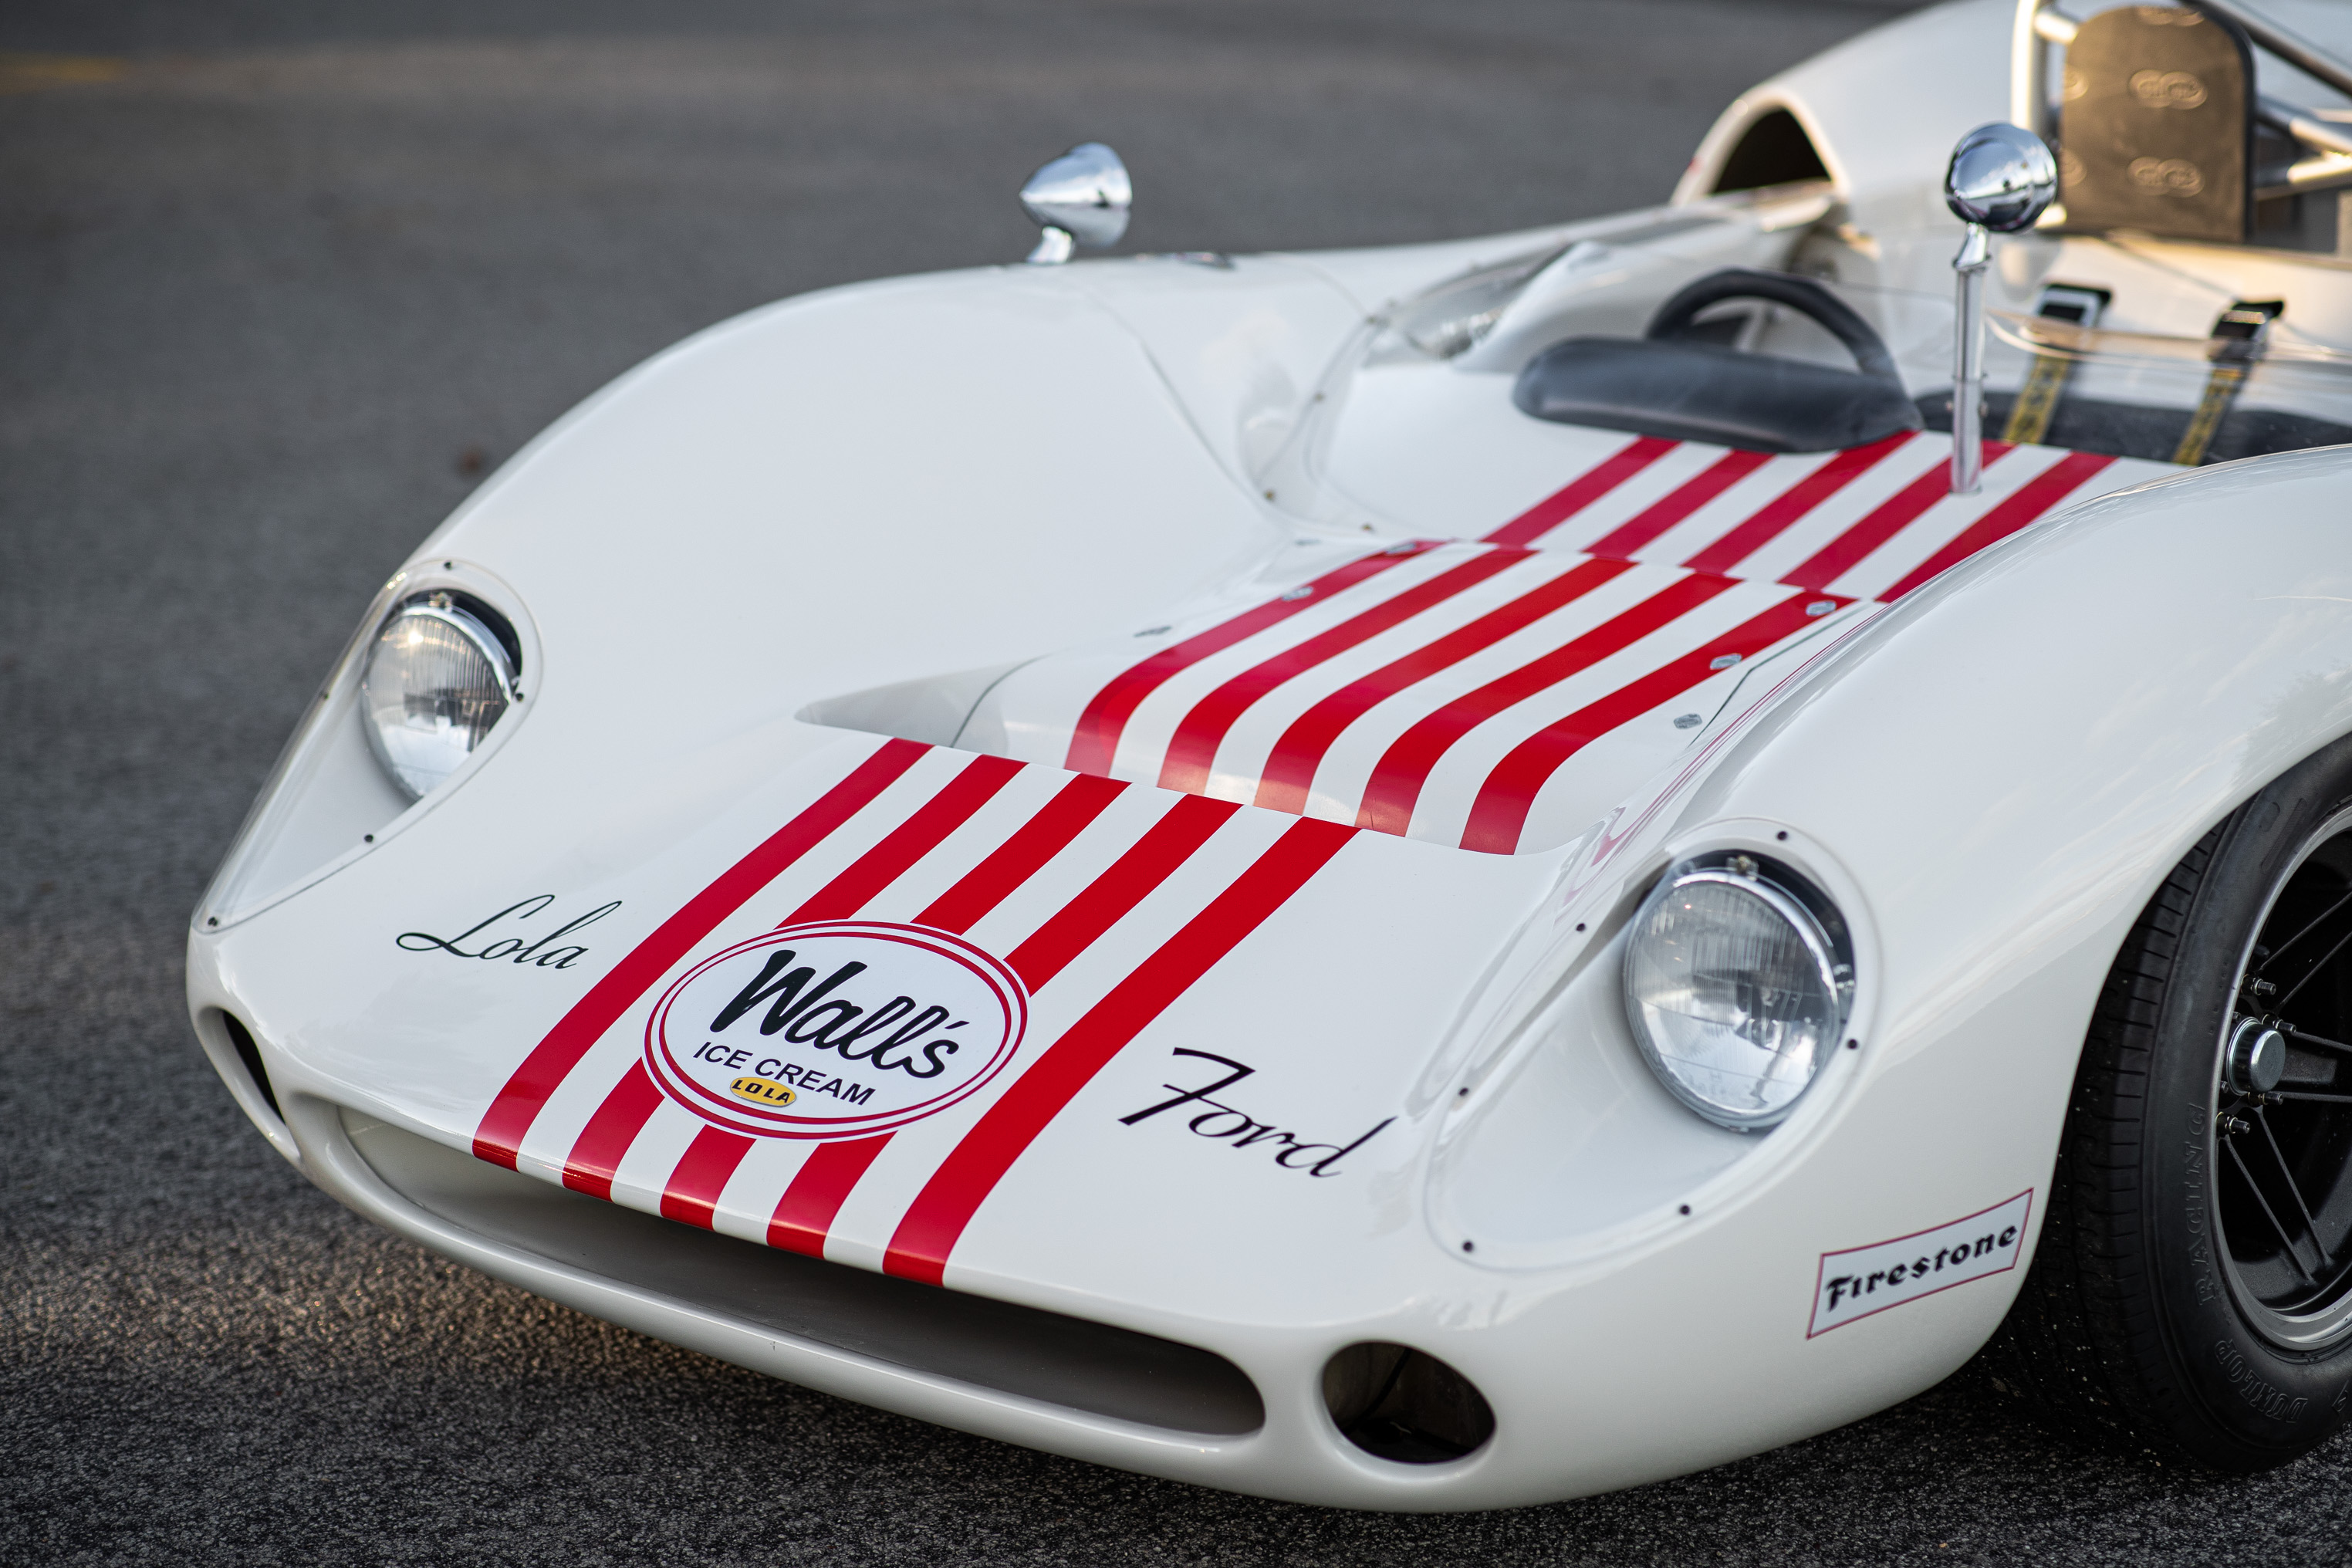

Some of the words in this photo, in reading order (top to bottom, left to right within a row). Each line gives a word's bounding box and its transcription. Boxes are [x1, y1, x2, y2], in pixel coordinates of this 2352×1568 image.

[396, 894, 623, 970] Lola
[709, 949, 970, 1079] Wall's
[692, 1041, 753, 1070] ICE
[754, 1058, 877, 1106] CREAM
[732, 1079, 791, 1103] LOLA
[1117, 1046, 1399, 1178] Ford
[2185, 1103, 2218, 1306] RACING
[1825, 1225, 2019, 1313] Firestone
[2214, 1338, 2309, 1424] DUNLOP
